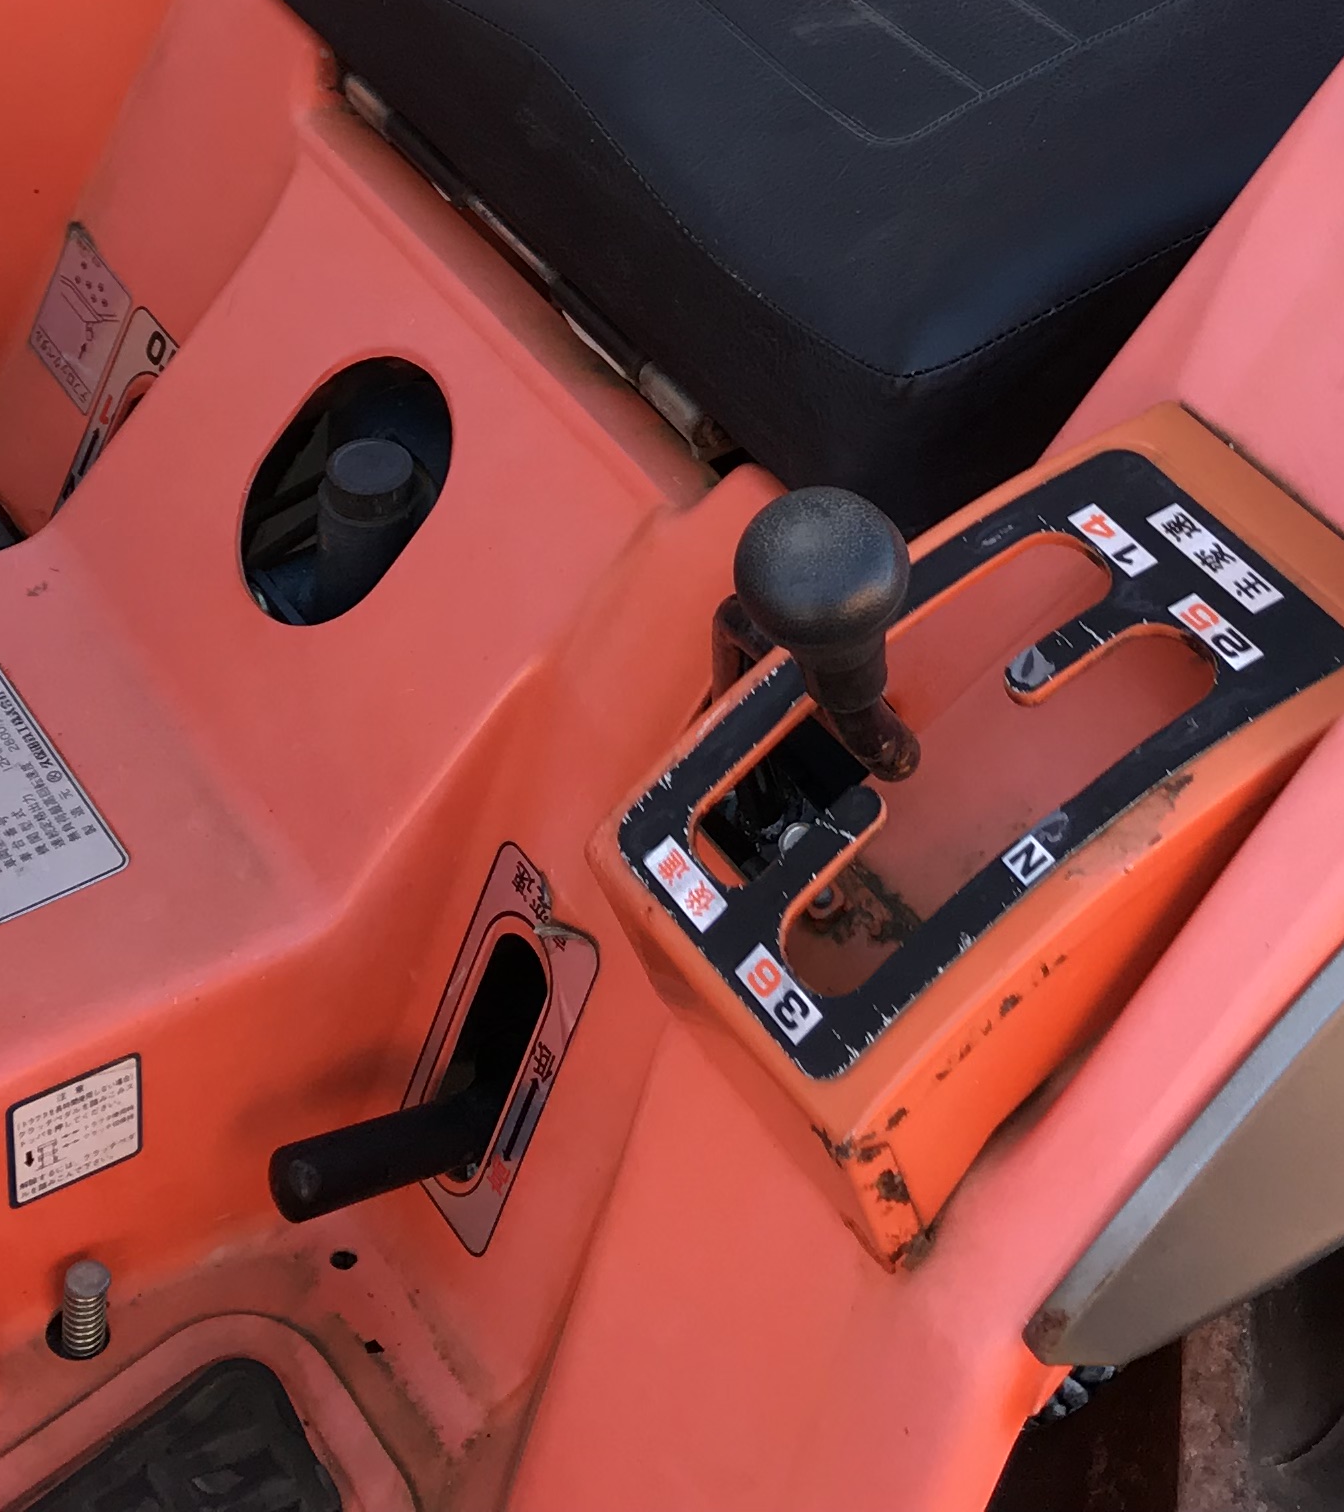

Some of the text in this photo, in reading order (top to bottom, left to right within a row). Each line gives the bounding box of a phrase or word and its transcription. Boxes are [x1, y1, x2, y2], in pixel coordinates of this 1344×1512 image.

[1161, 511, 1272, 600] 主変速
[1009, 842, 1047, 877] N
[533, 1040, 557, 1084] 低
